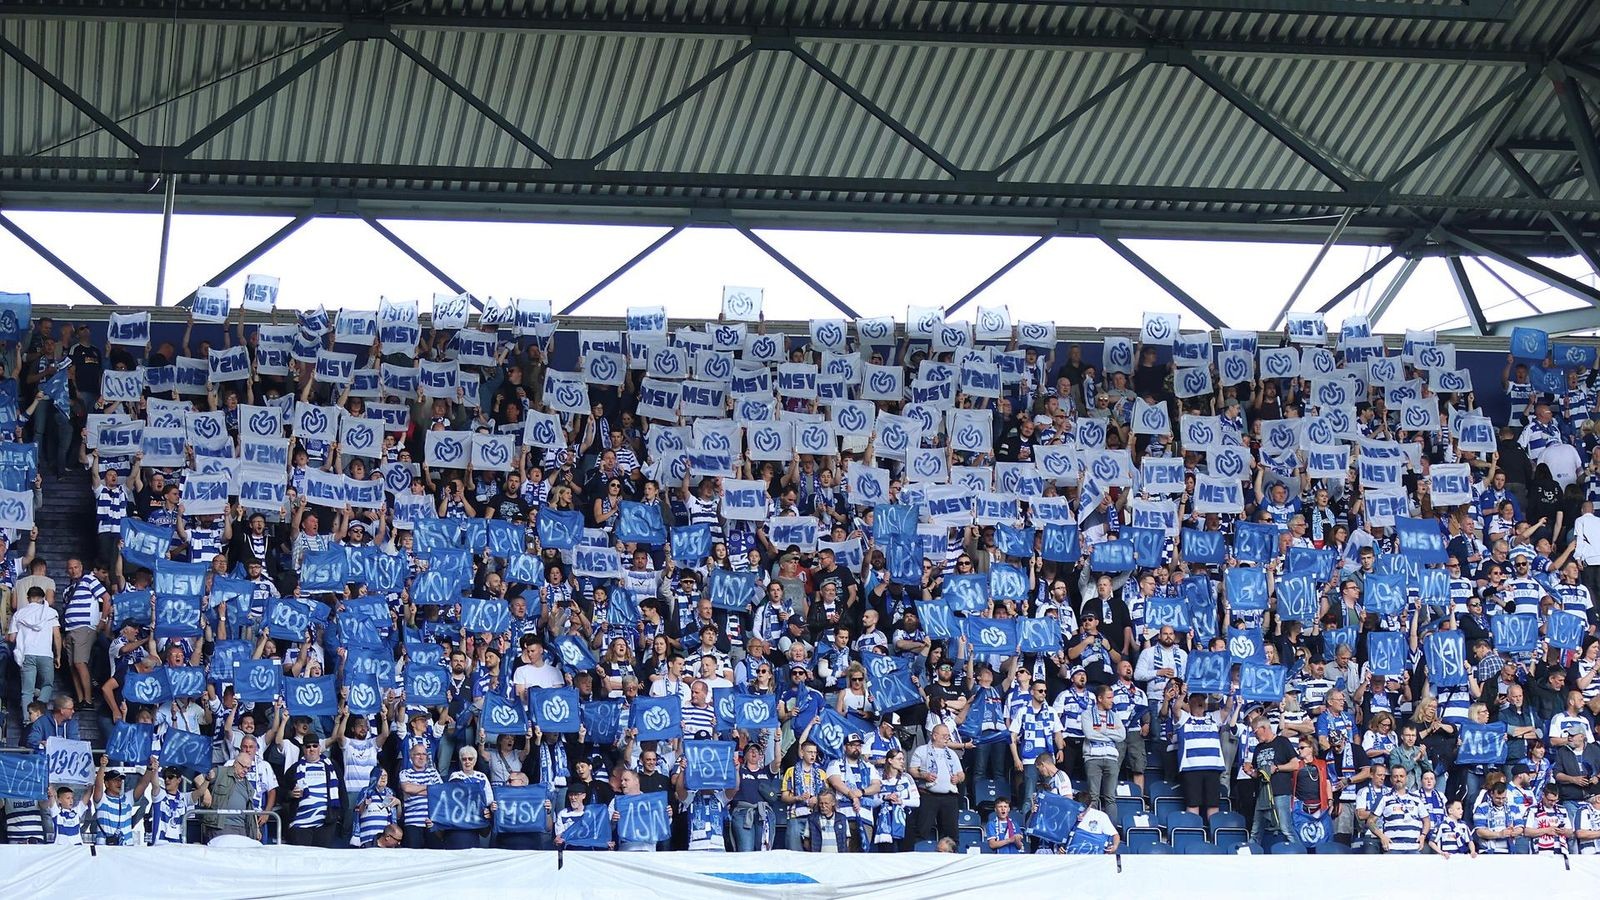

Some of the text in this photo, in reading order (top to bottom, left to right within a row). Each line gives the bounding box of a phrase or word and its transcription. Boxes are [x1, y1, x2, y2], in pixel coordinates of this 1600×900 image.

[244, 283, 279, 304] MSV
[193, 296, 229, 317] MSV
[381, 327, 417, 344] MSV
[1290, 320, 1324, 335] MSV
[459, 339, 496, 357] MSV
[1175, 340, 1208, 360] MSV
[1347, 347, 1383, 363] MSV
[317, 358, 352, 377] MSV
[421, 367, 456, 387] MSV
[732, 374, 768, 392] MSV
[779, 373, 815, 389] MSV
[642, 388, 677, 408] MSV
[683, 387, 722, 407] MSV
[914, 384, 950, 403] MSV
[367, 408, 407, 425] MSV
[100, 429, 143, 446] MSV
[143, 437, 184, 456] MSV
[1310, 452, 1347, 470] MSV
[1361, 462, 1397, 482] MSV
[241, 482, 285, 501] MSV
[307, 482, 343, 500] MSV
[344, 484, 382, 502] MSV
[1199, 484, 1237, 503] MSV
[1432, 476, 1469, 494] MSV
[726, 490, 766, 508] MSV
[930, 496, 974, 515] MSV
[877, 505, 911, 536] MSV
[1136, 511, 1174, 528] MSV
[540, 520, 577, 543] MSV
[774, 525, 816, 543] MSV
[1045, 528, 1075, 554] MSV
[1399, 530, 1442, 551] MSV
[127, 528, 170, 558] MSV
[672, 530, 709, 556] MSV
[1184, 530, 1218, 555] MSV
[1094, 545, 1133, 563] MSV
[300, 562, 342, 583] MSV
[365, 558, 402, 589] MSV
[511, 555, 544, 583] MSV
[156, 573, 203, 595] MSV
[415, 571, 457, 601] MSV
[711, 575, 754, 607] MSV
[159, 600, 198, 629] 1902
[464, 601, 508, 633] MSV
[918, 604, 949, 636] MSV
[1021, 622, 1056, 648] MSV
[1497, 620, 1530, 646] MSV
[1243, 668, 1283, 694] MSV
[50, 750, 93, 778] 1902
[688, 746, 731, 780] MSV
[500, 801, 544, 823] MSV
